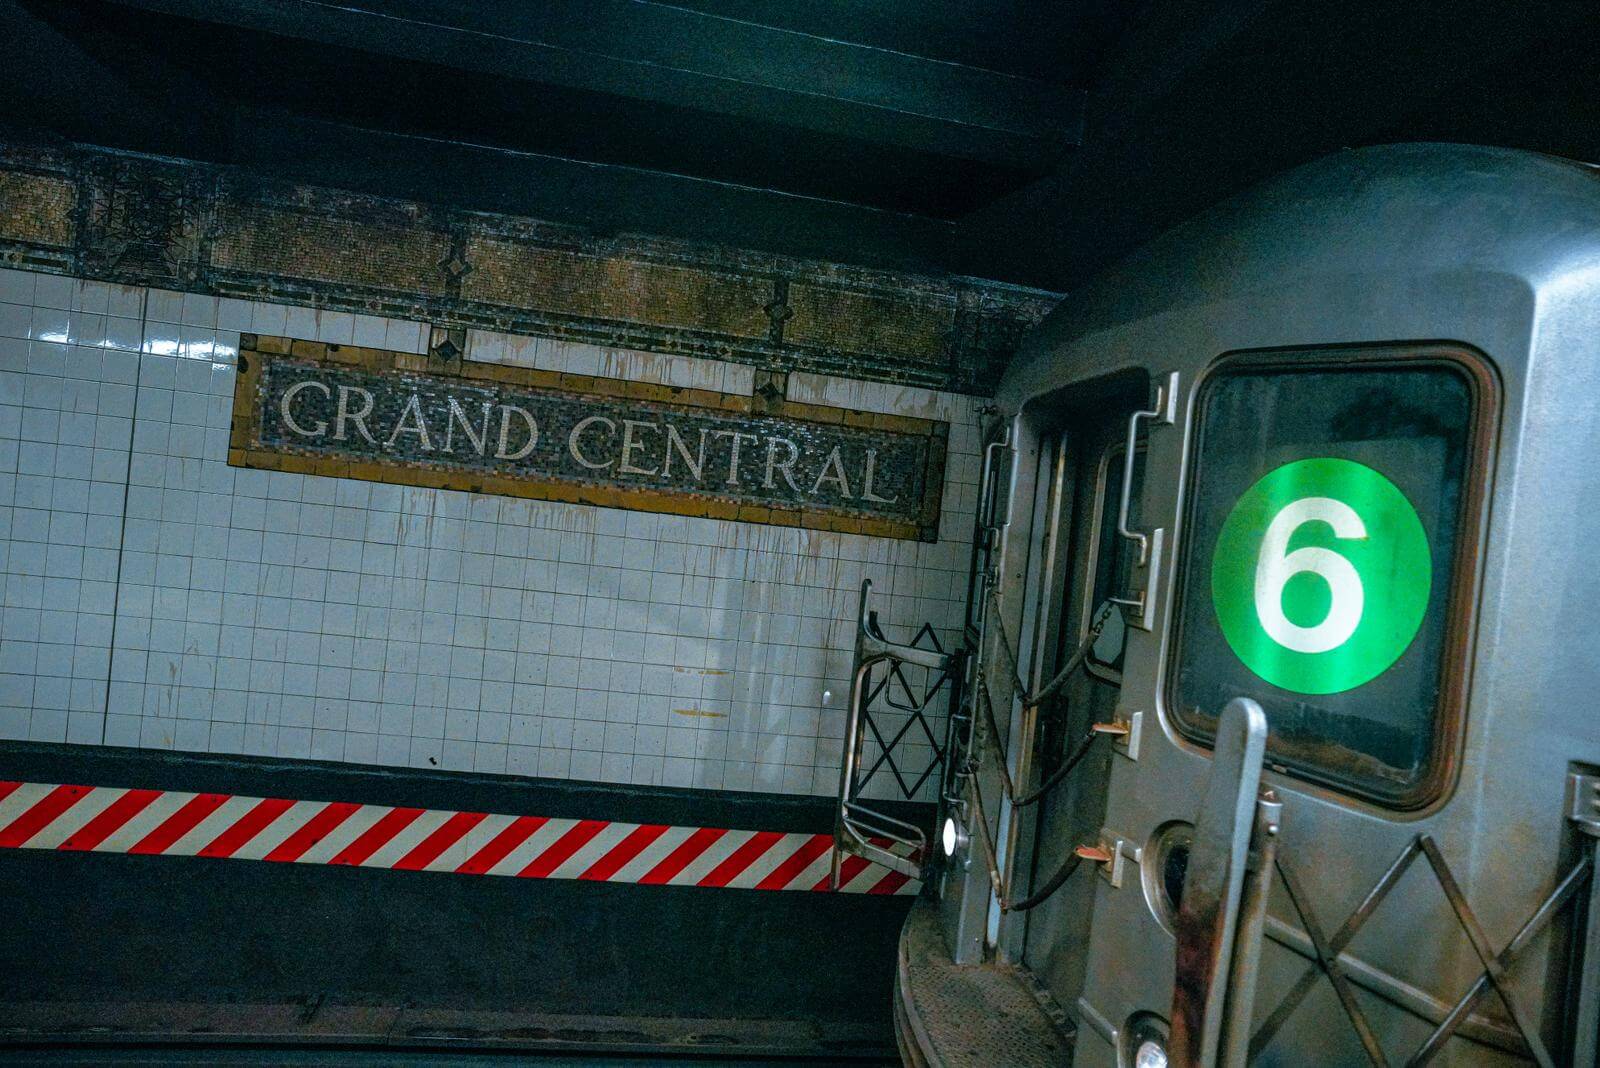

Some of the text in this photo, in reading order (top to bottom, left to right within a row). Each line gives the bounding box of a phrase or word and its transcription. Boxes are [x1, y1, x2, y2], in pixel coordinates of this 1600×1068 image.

[281, 381, 899, 502] GRAND CENTRAL
[1254, 497, 1367, 653] 6
